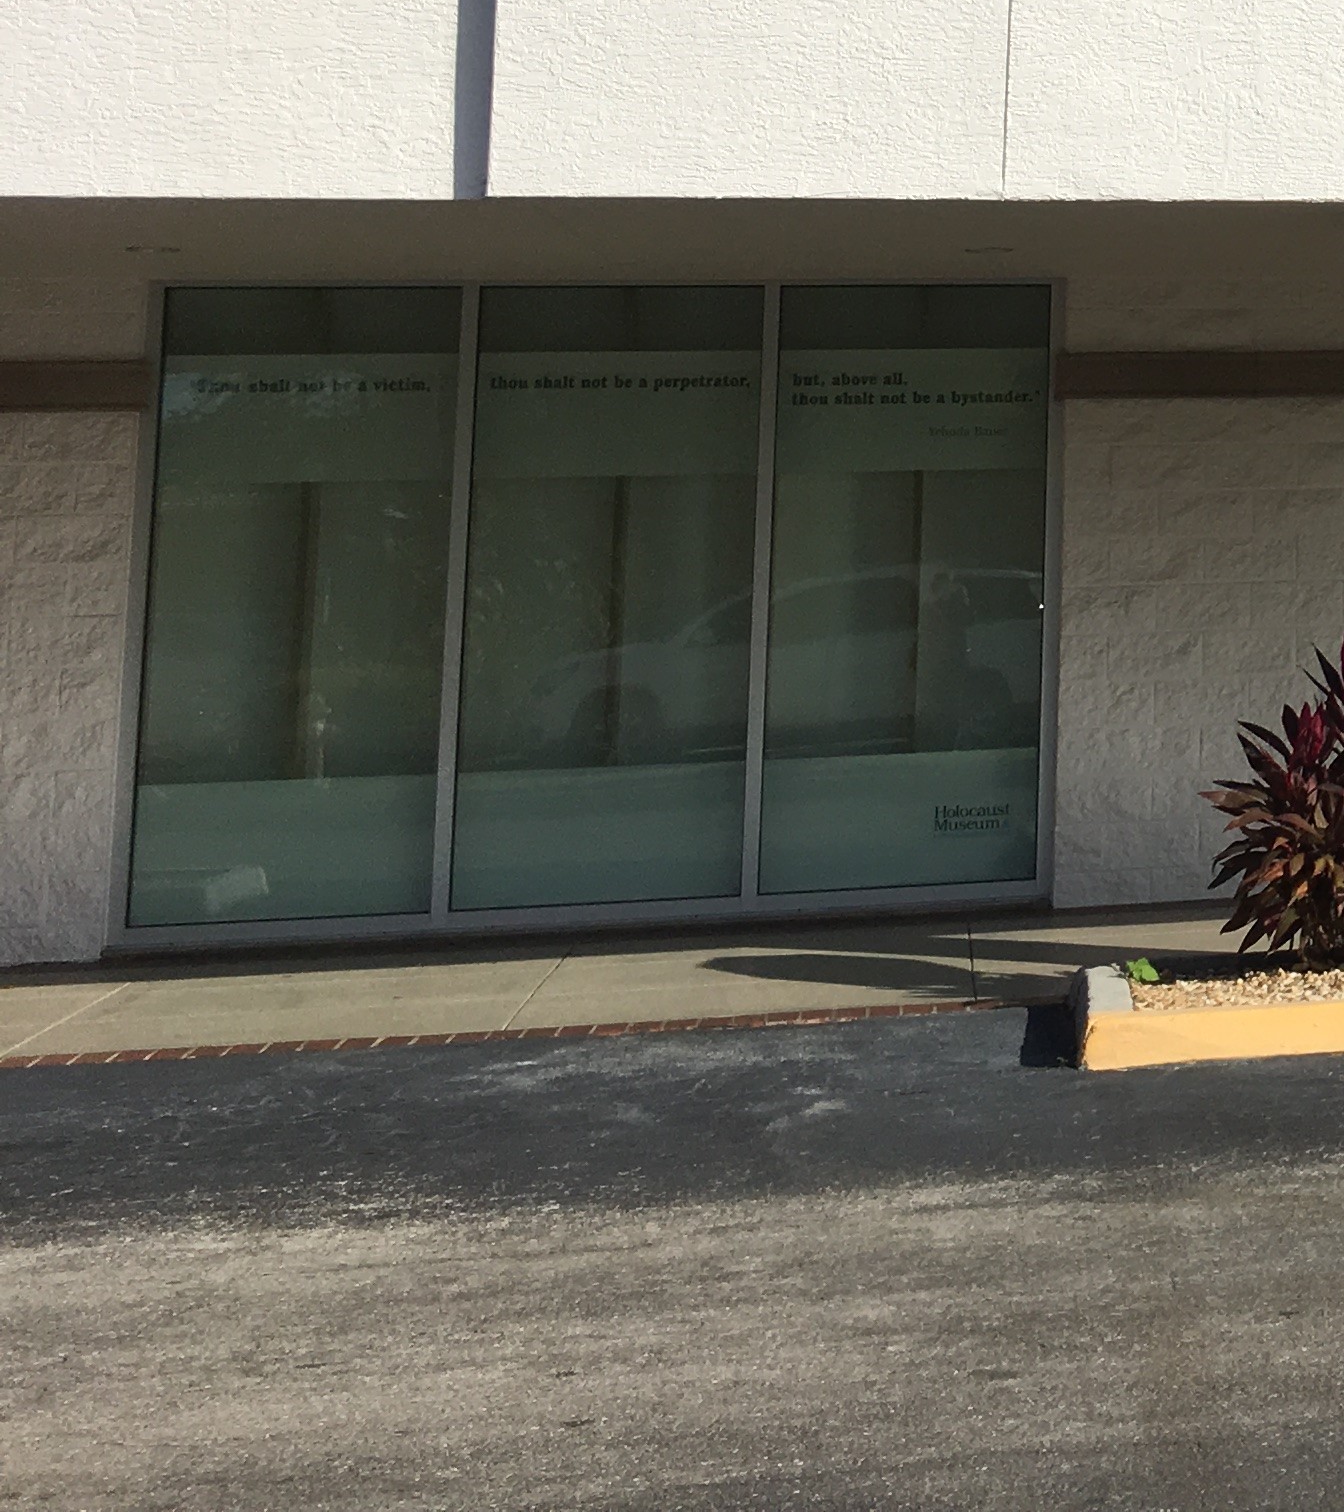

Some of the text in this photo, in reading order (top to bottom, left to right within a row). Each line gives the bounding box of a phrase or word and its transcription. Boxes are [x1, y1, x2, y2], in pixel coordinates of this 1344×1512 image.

[357, 379, 368, 392] a
[490, 375, 751, 393] thou shalt not be a perpetrator,
[831, 372, 877, 386] above
[791, 391, 829, 406] thou
[834, 391, 875, 405] shalt
[880, 392, 907, 404] not
[912, 390, 931, 404] be
[935, 392, 946, 404] a
[934, 803, 1010, 819] Holocaust
[934, 818, 1001, 832] Museum
